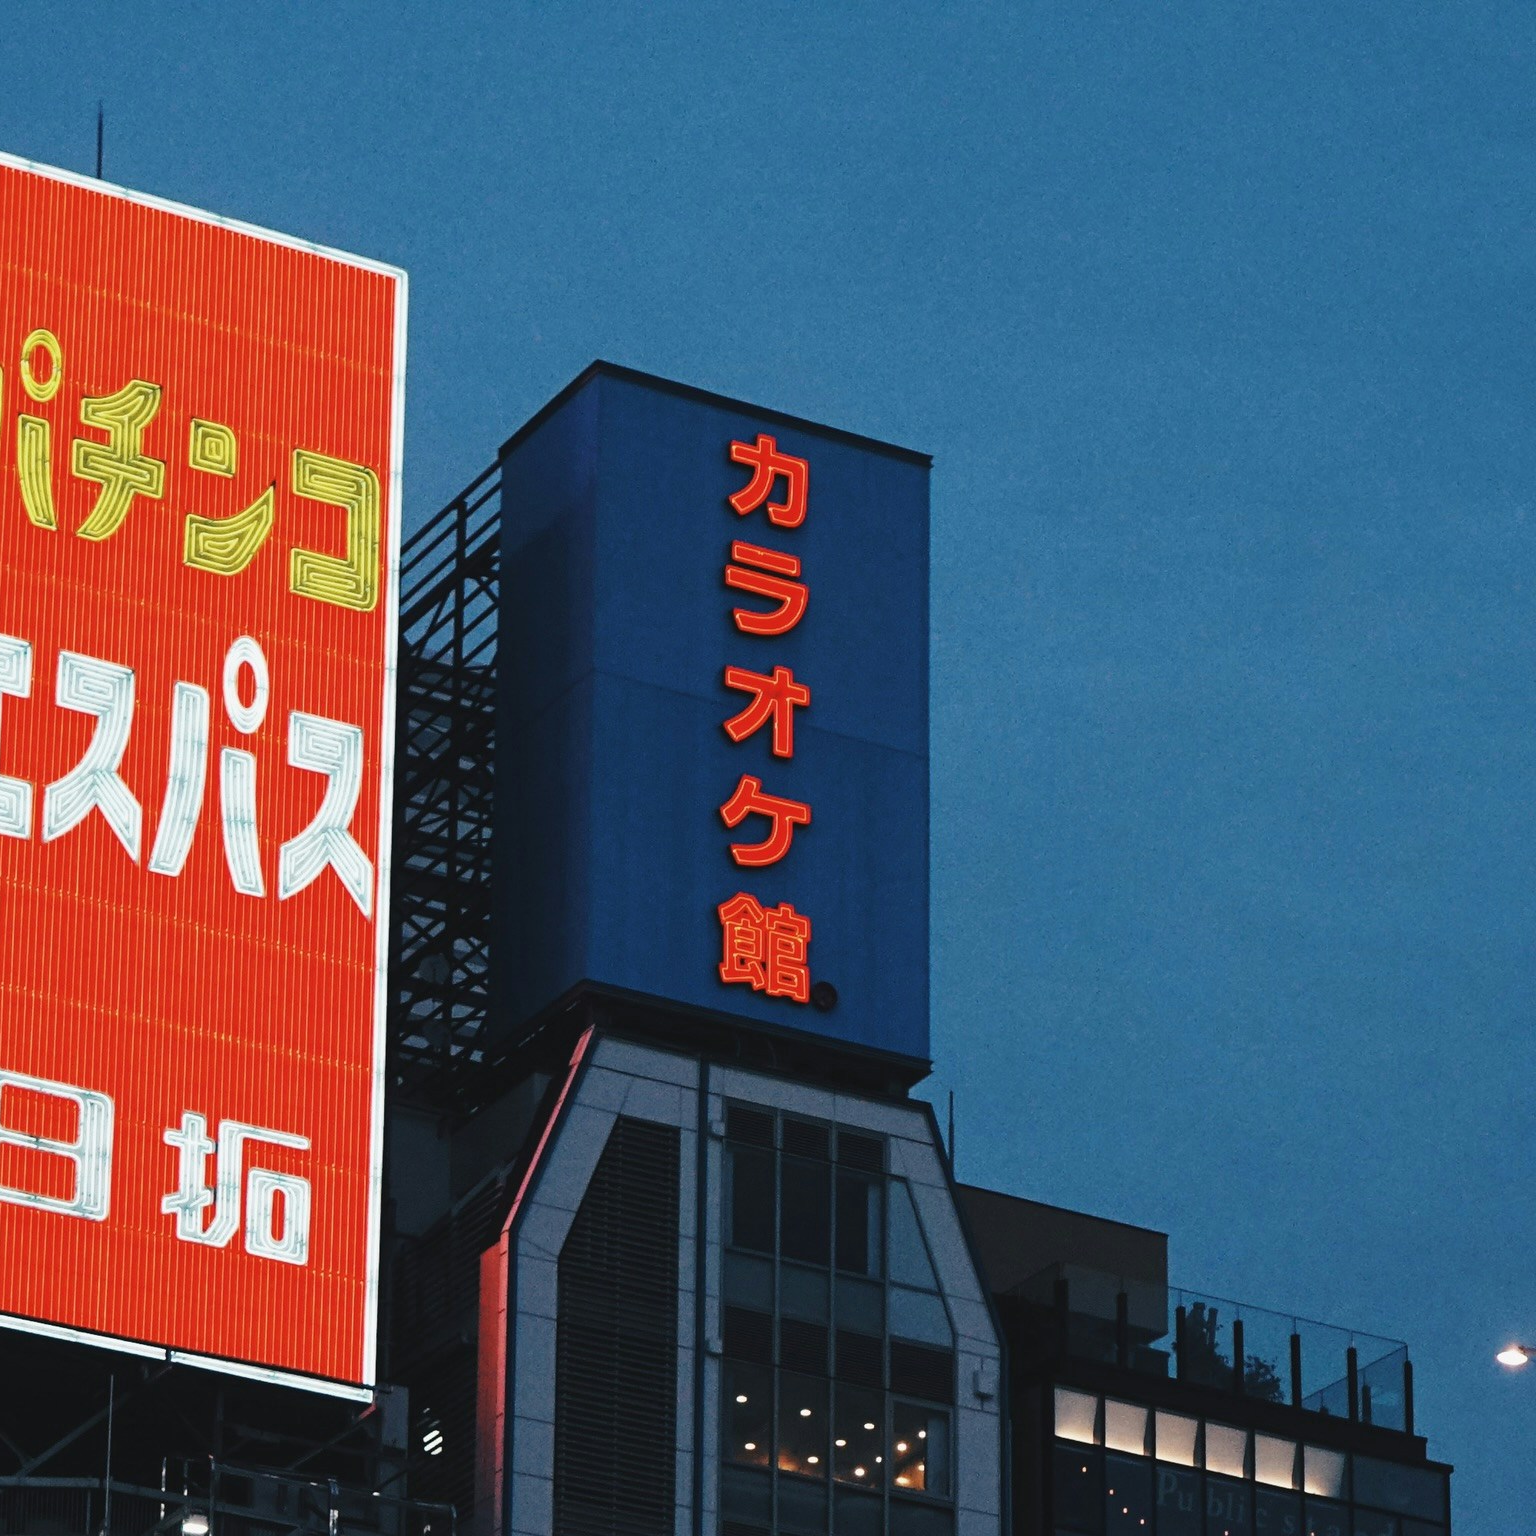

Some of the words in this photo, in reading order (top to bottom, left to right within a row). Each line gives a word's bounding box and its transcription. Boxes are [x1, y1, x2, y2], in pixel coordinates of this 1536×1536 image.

[718, 433, 811, 1004] カラオケ館
